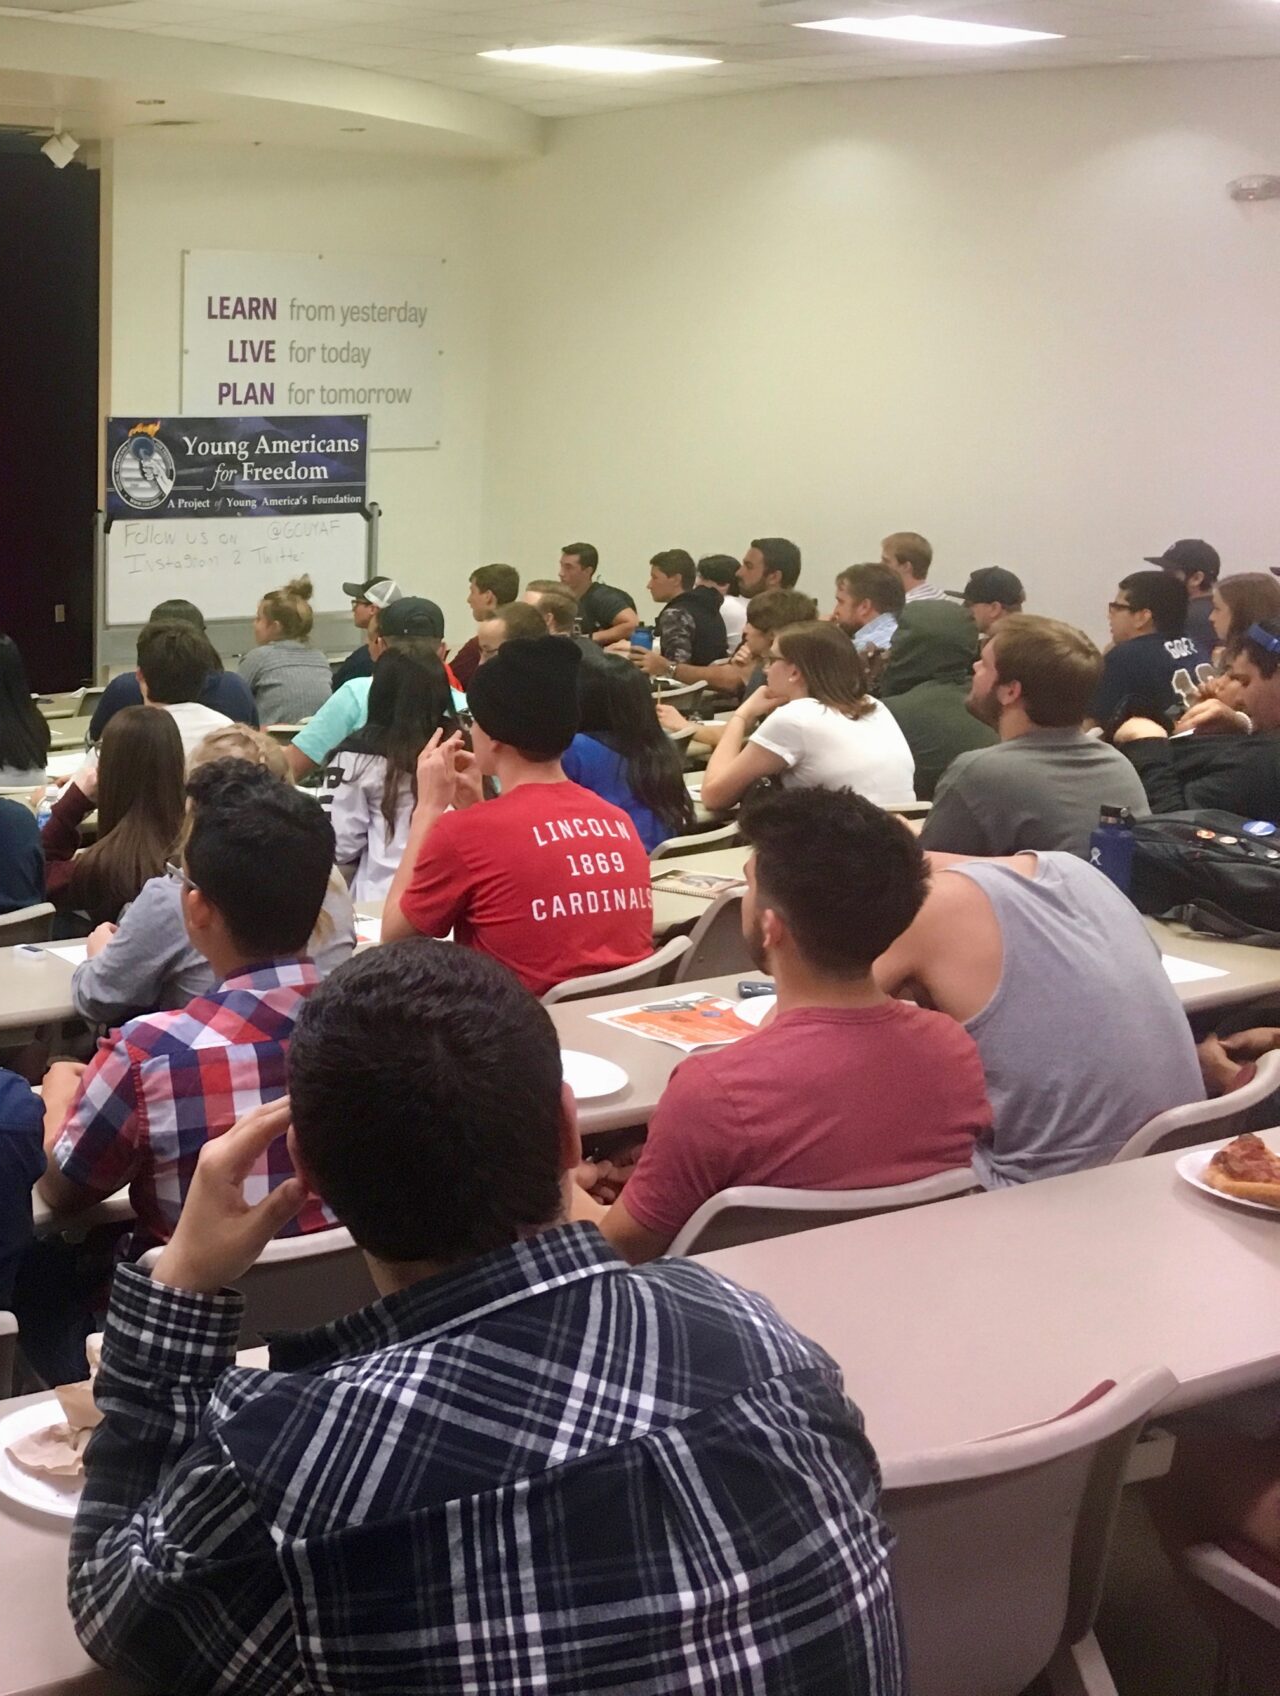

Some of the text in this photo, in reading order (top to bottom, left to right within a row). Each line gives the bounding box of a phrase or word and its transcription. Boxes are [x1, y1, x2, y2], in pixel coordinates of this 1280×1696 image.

[207, 296, 428, 328] LEARN from yesterday
[229, 340, 371, 368] LIVE for today
[218, 382, 412, 405] PLAN for tomorrow
[182, 436, 250, 461] Young
[254, 434, 360, 454] Americans
[206, 461, 329, 491] for Freedom
[167, 500, 175, 508] A
[177, 499, 210, 510] Project
[226, 498, 257, 509] Young
[261, 495, 308, 507] America's
[312, 494, 362, 505] Foundation
[532, 818, 631, 847] LINCOLN
[566, 852, 625, 876] 1869
[531, 887, 653, 921] CARDINALS
